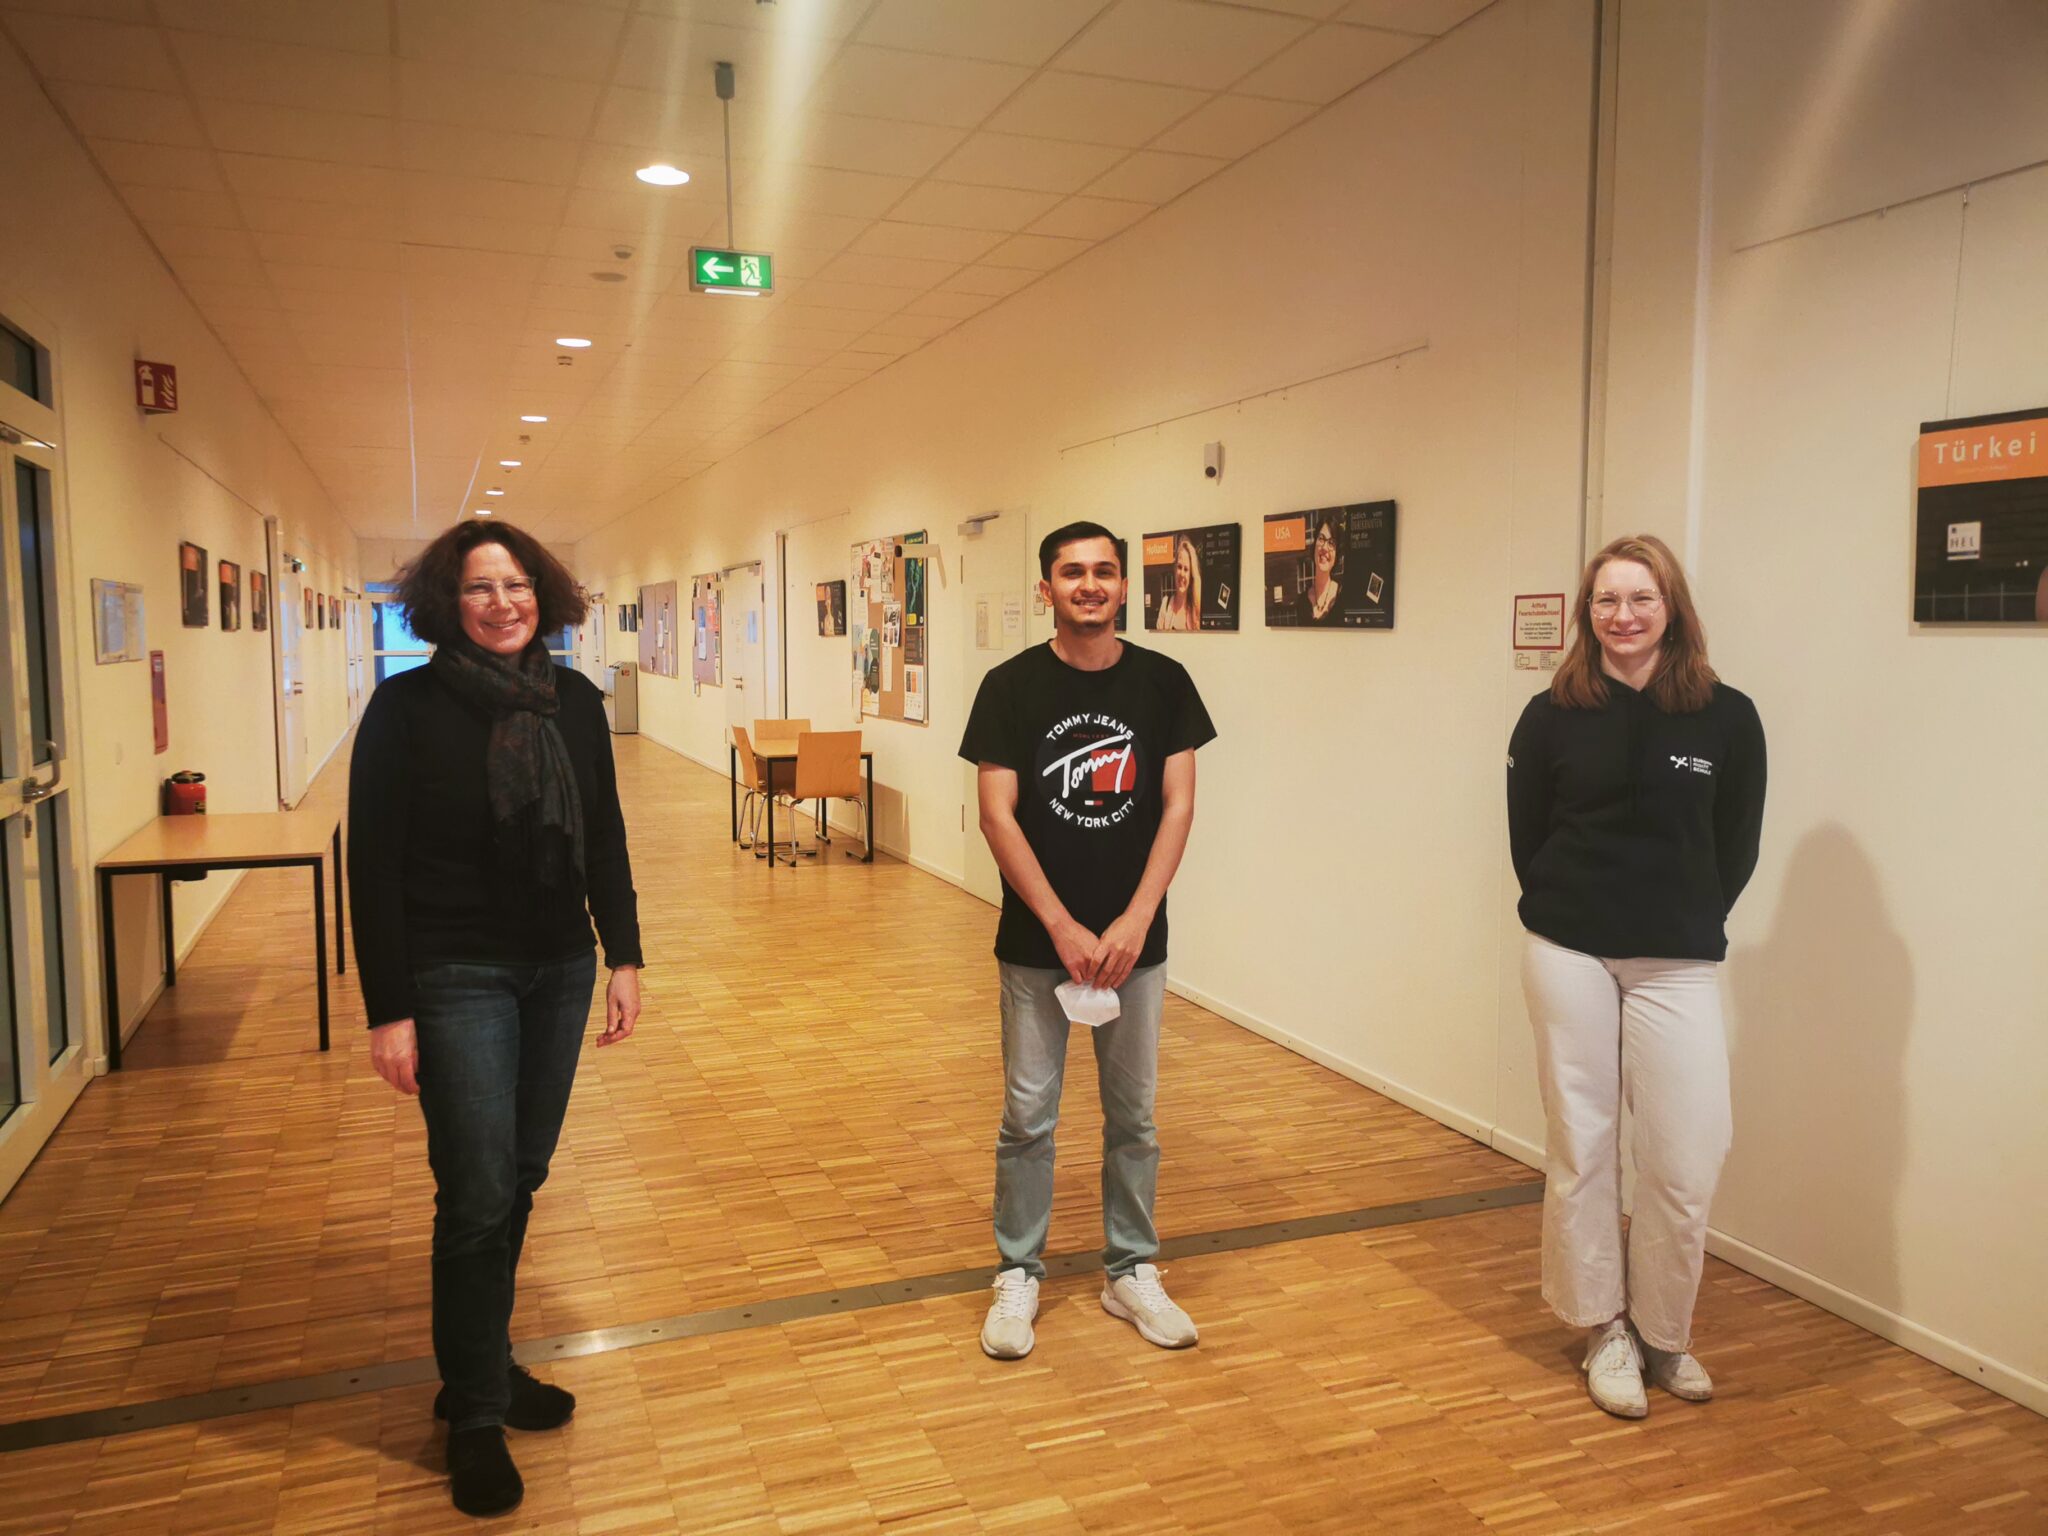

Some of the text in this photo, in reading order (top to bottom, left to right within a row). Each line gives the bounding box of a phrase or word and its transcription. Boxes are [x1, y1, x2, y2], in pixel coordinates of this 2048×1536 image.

[1934, 431, 2037, 465] Türkei
[1275, 526, 1291, 540] USA
[1046, 713, 1134, 741] TOMMY JEANS
[1042, 734, 1131, 799] Tommy
[1049, 797, 1135, 828] NEW YORK CITY
